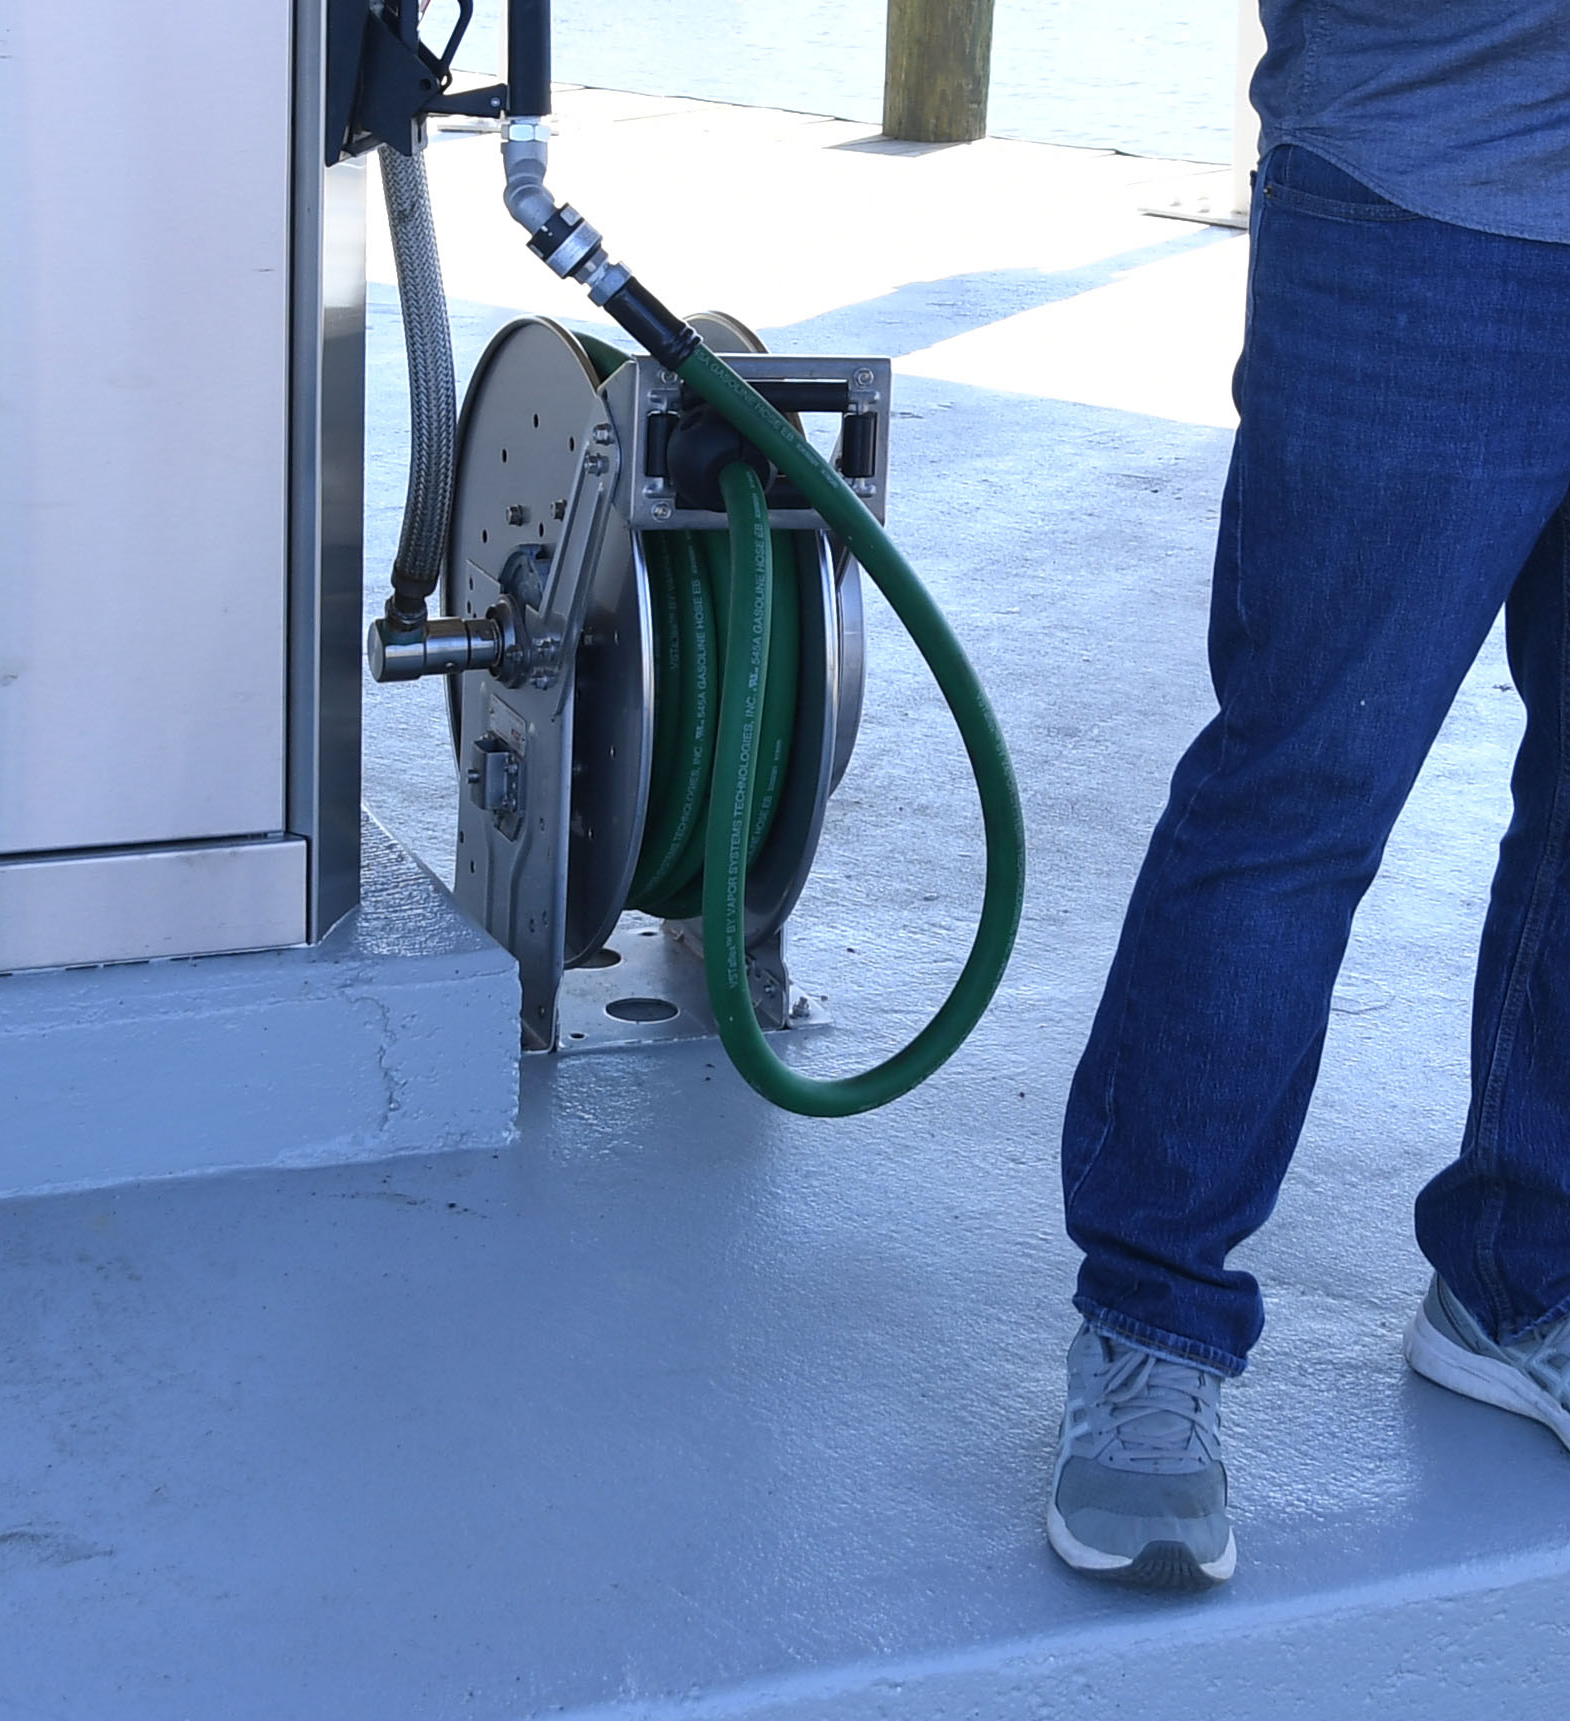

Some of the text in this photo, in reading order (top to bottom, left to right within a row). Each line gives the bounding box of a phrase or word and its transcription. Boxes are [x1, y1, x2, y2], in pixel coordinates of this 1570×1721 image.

[709, 363, 754, 405] GASOLINE
[754, 402, 781, 427] HOSE
[753, 523, 764, 538] EB
[754, 540, 766, 573] HOSE
[693, 597, 705, 629] HOSE
[752, 574, 766, 634] GASOLINE
[695, 632, 707, 689] GASOLINE
[751, 637, 762, 665] 545A
[733, 721, 756, 817] TECHNOLOGIES,
[728, 820, 744, 879] SYSTEMS
[726, 880, 738, 917] VAPOR
